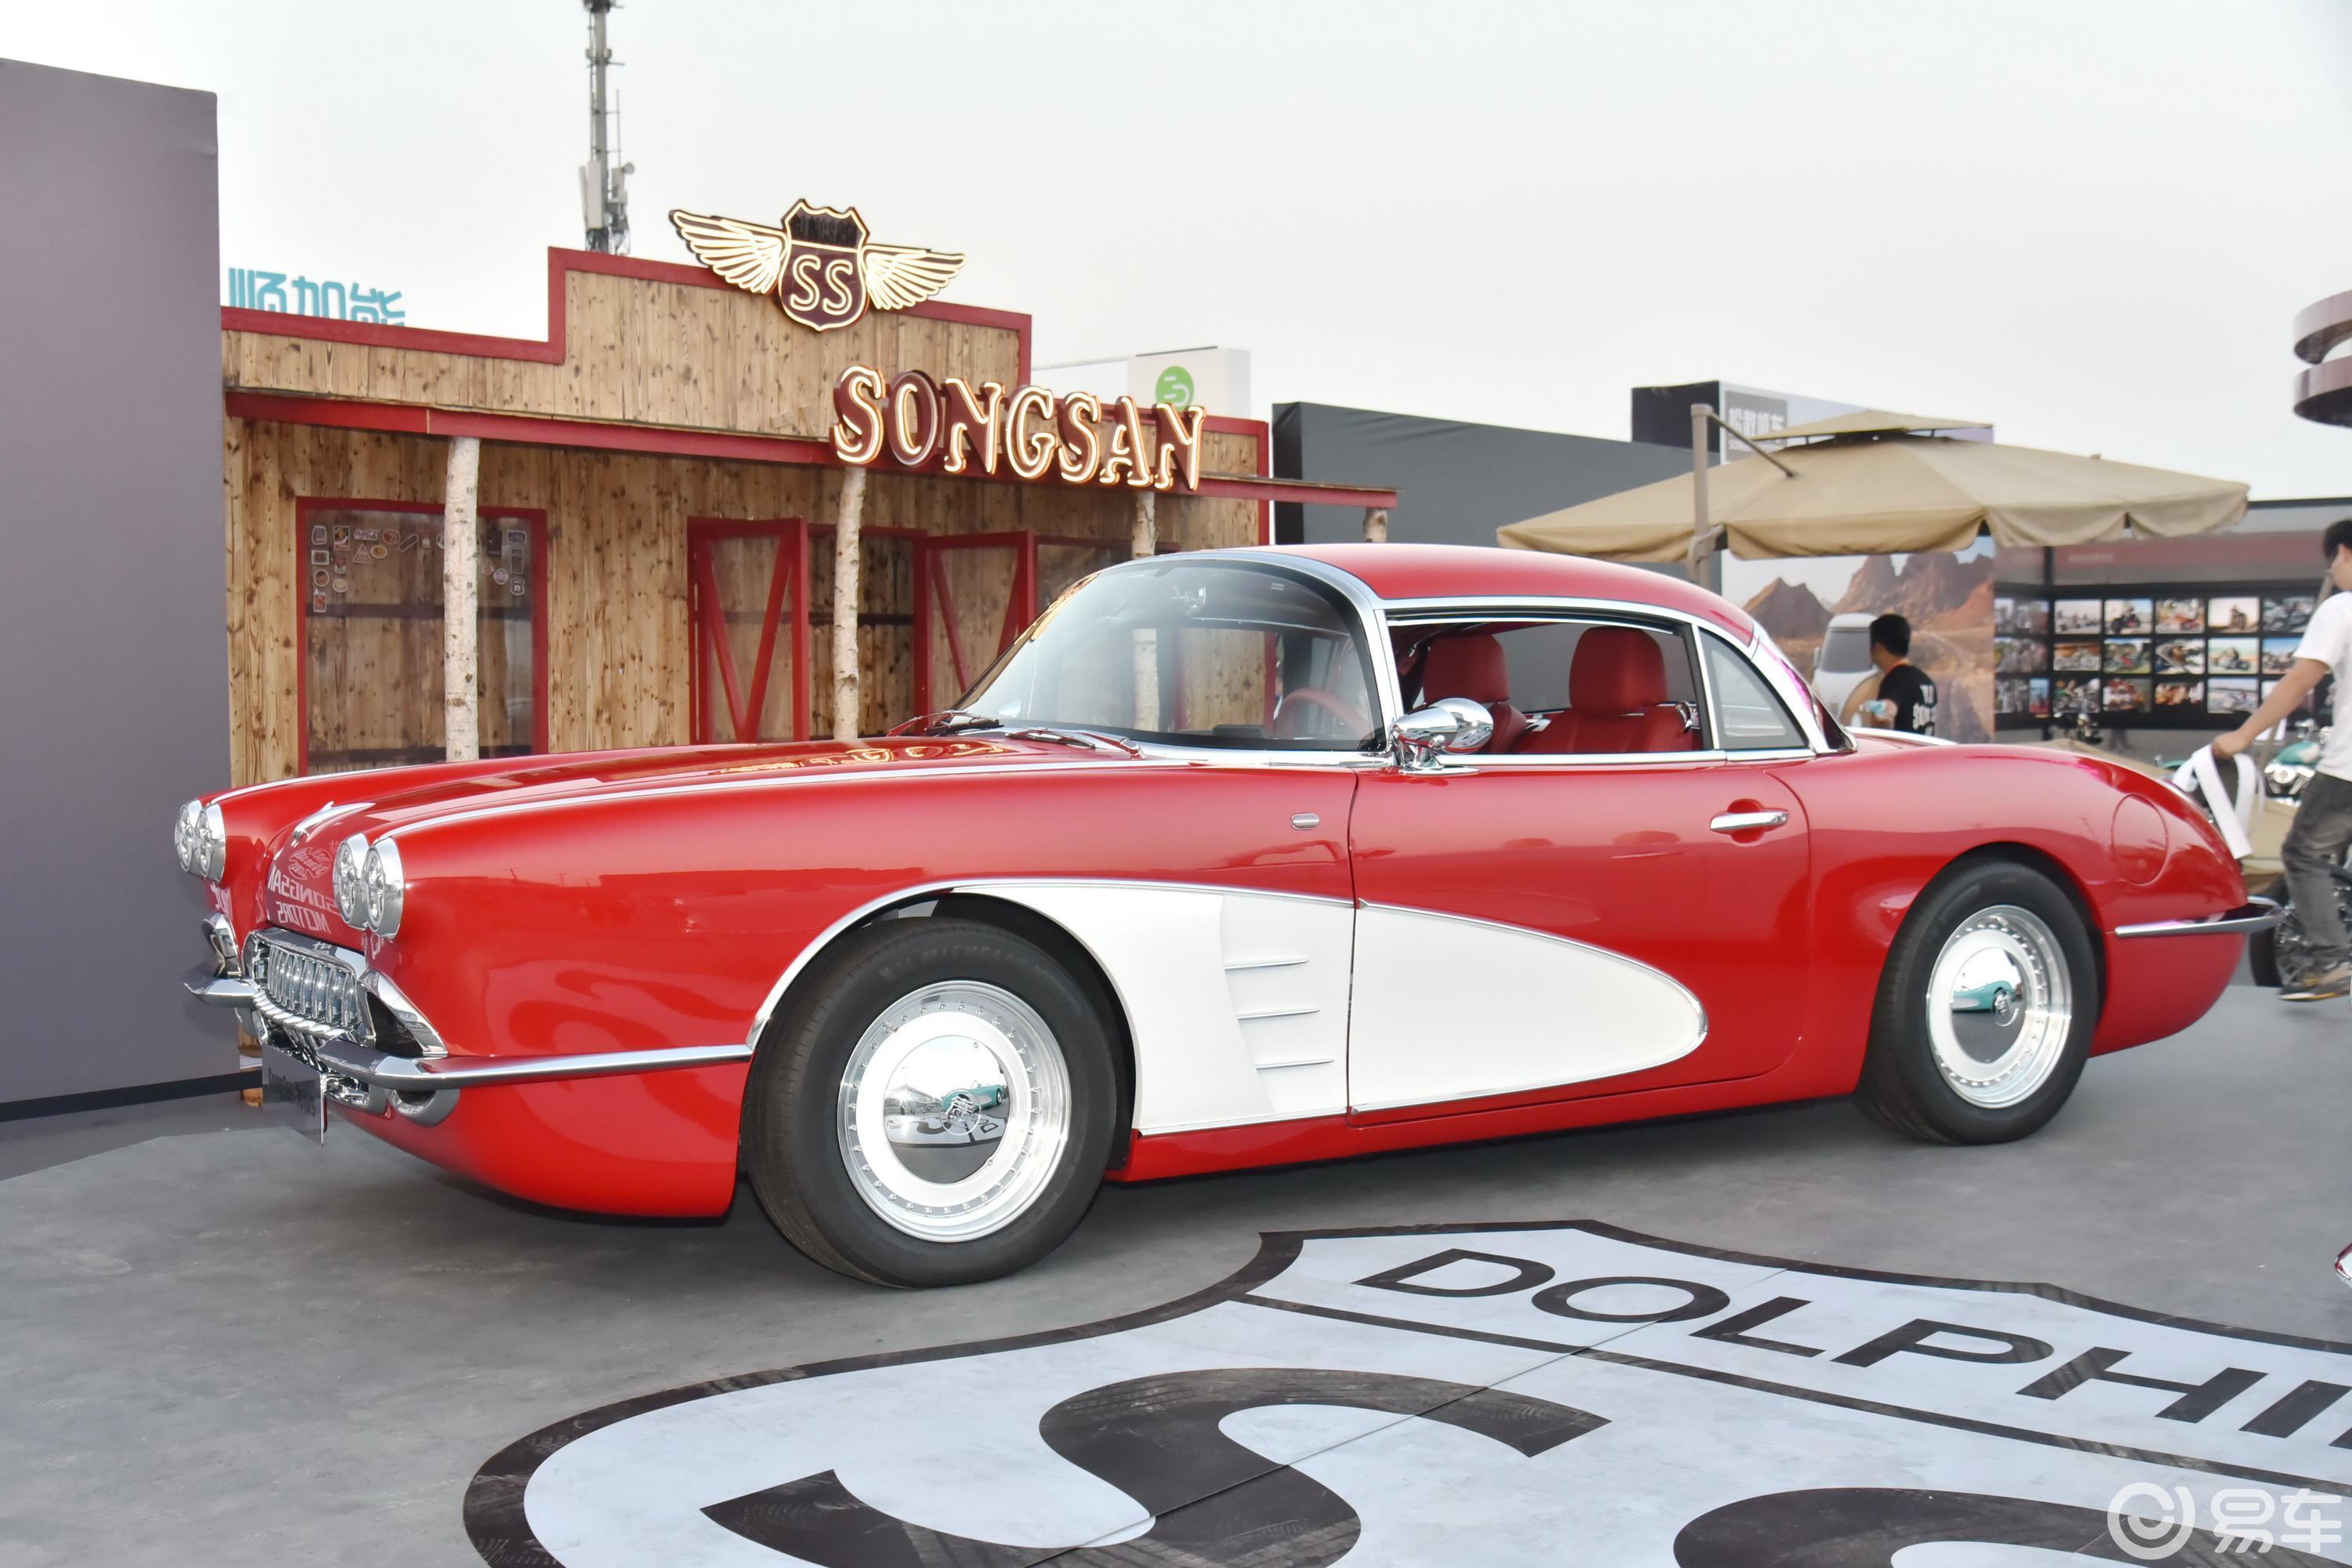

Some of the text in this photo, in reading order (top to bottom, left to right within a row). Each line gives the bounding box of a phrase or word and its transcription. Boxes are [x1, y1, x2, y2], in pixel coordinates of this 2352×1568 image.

[789, 254, 854, 315] SS
[831, 365, 1207, 492] SONGSAN
[1352, 1248, 2352, 1450] DOLPHI
